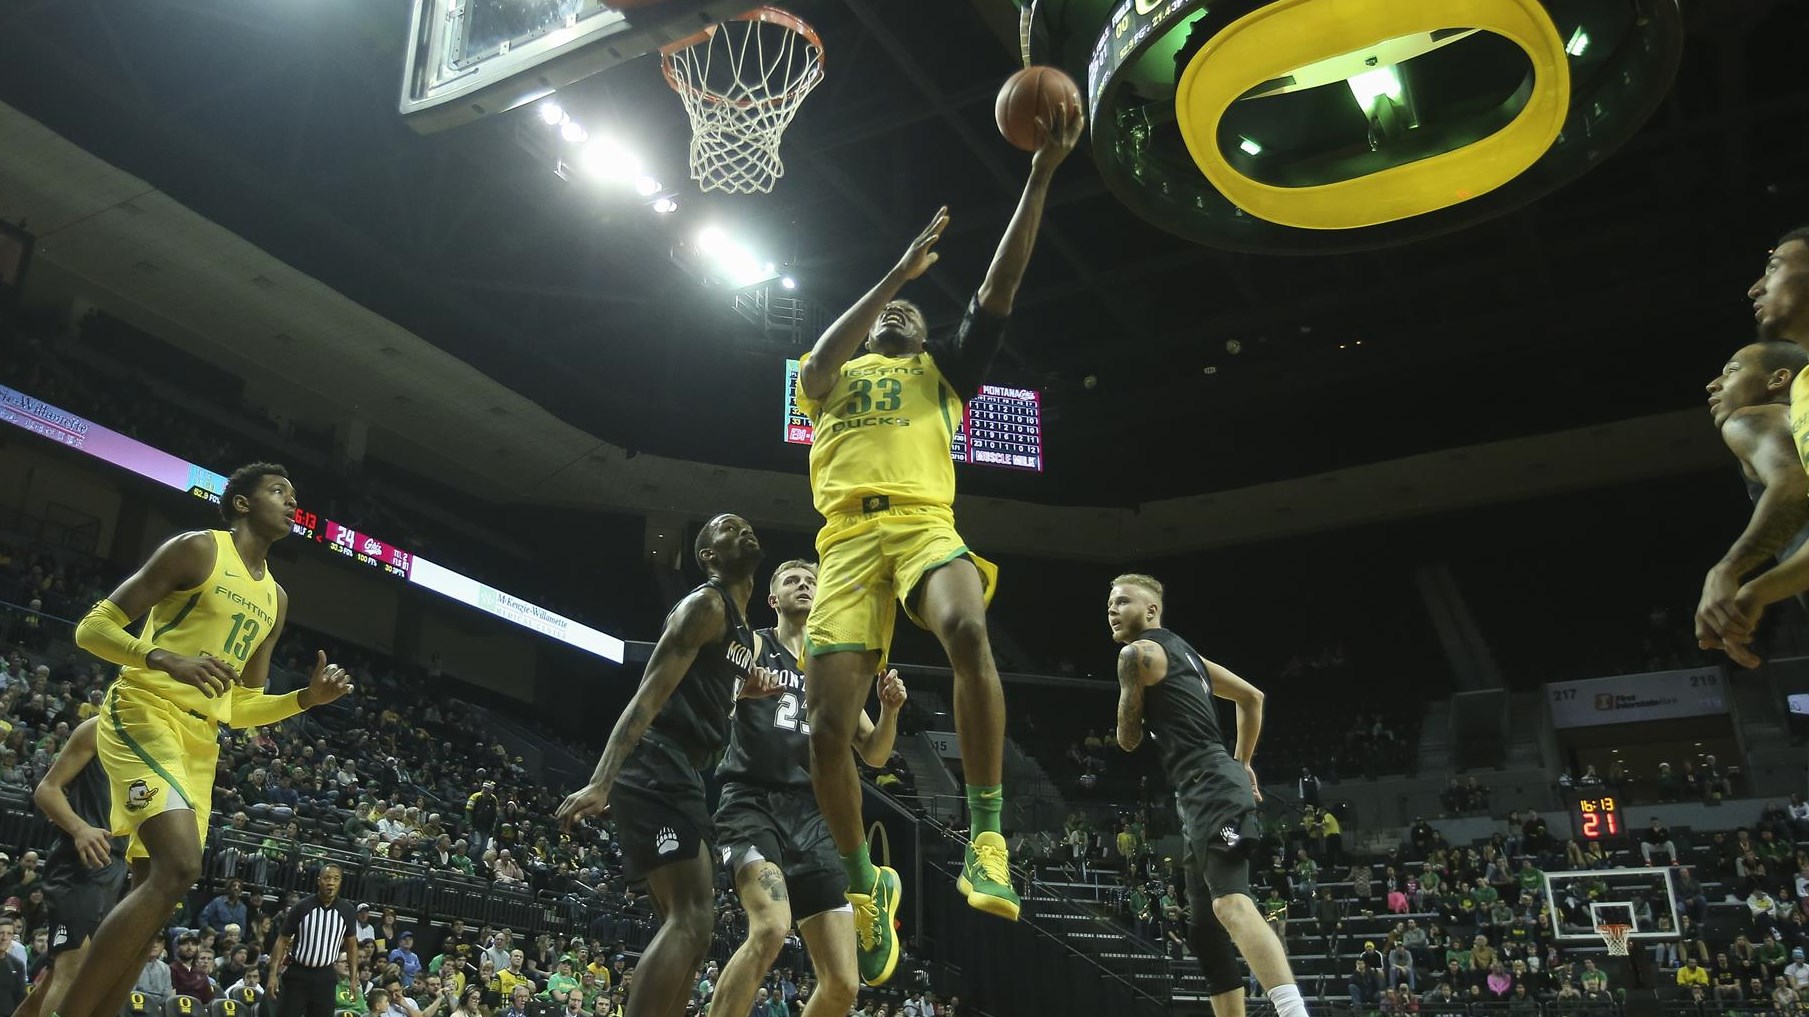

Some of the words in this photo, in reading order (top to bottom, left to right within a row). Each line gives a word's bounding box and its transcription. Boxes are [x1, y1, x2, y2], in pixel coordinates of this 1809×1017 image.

[847, 378, 901, 414] 33
[983, 385, 1021, 397] MONTANA
[832, 417, 910, 432] DUCKS
[294, 508, 317, 529] 6:13
[336, 525, 355, 549] 24
[215, 586, 274, 627] FIGHTING
[223, 612, 260, 661] 13
[1553, 688, 1577, 702] 217
[1580, 797, 1614, 812] 16:13
[1583, 813, 1615, 837] 21
